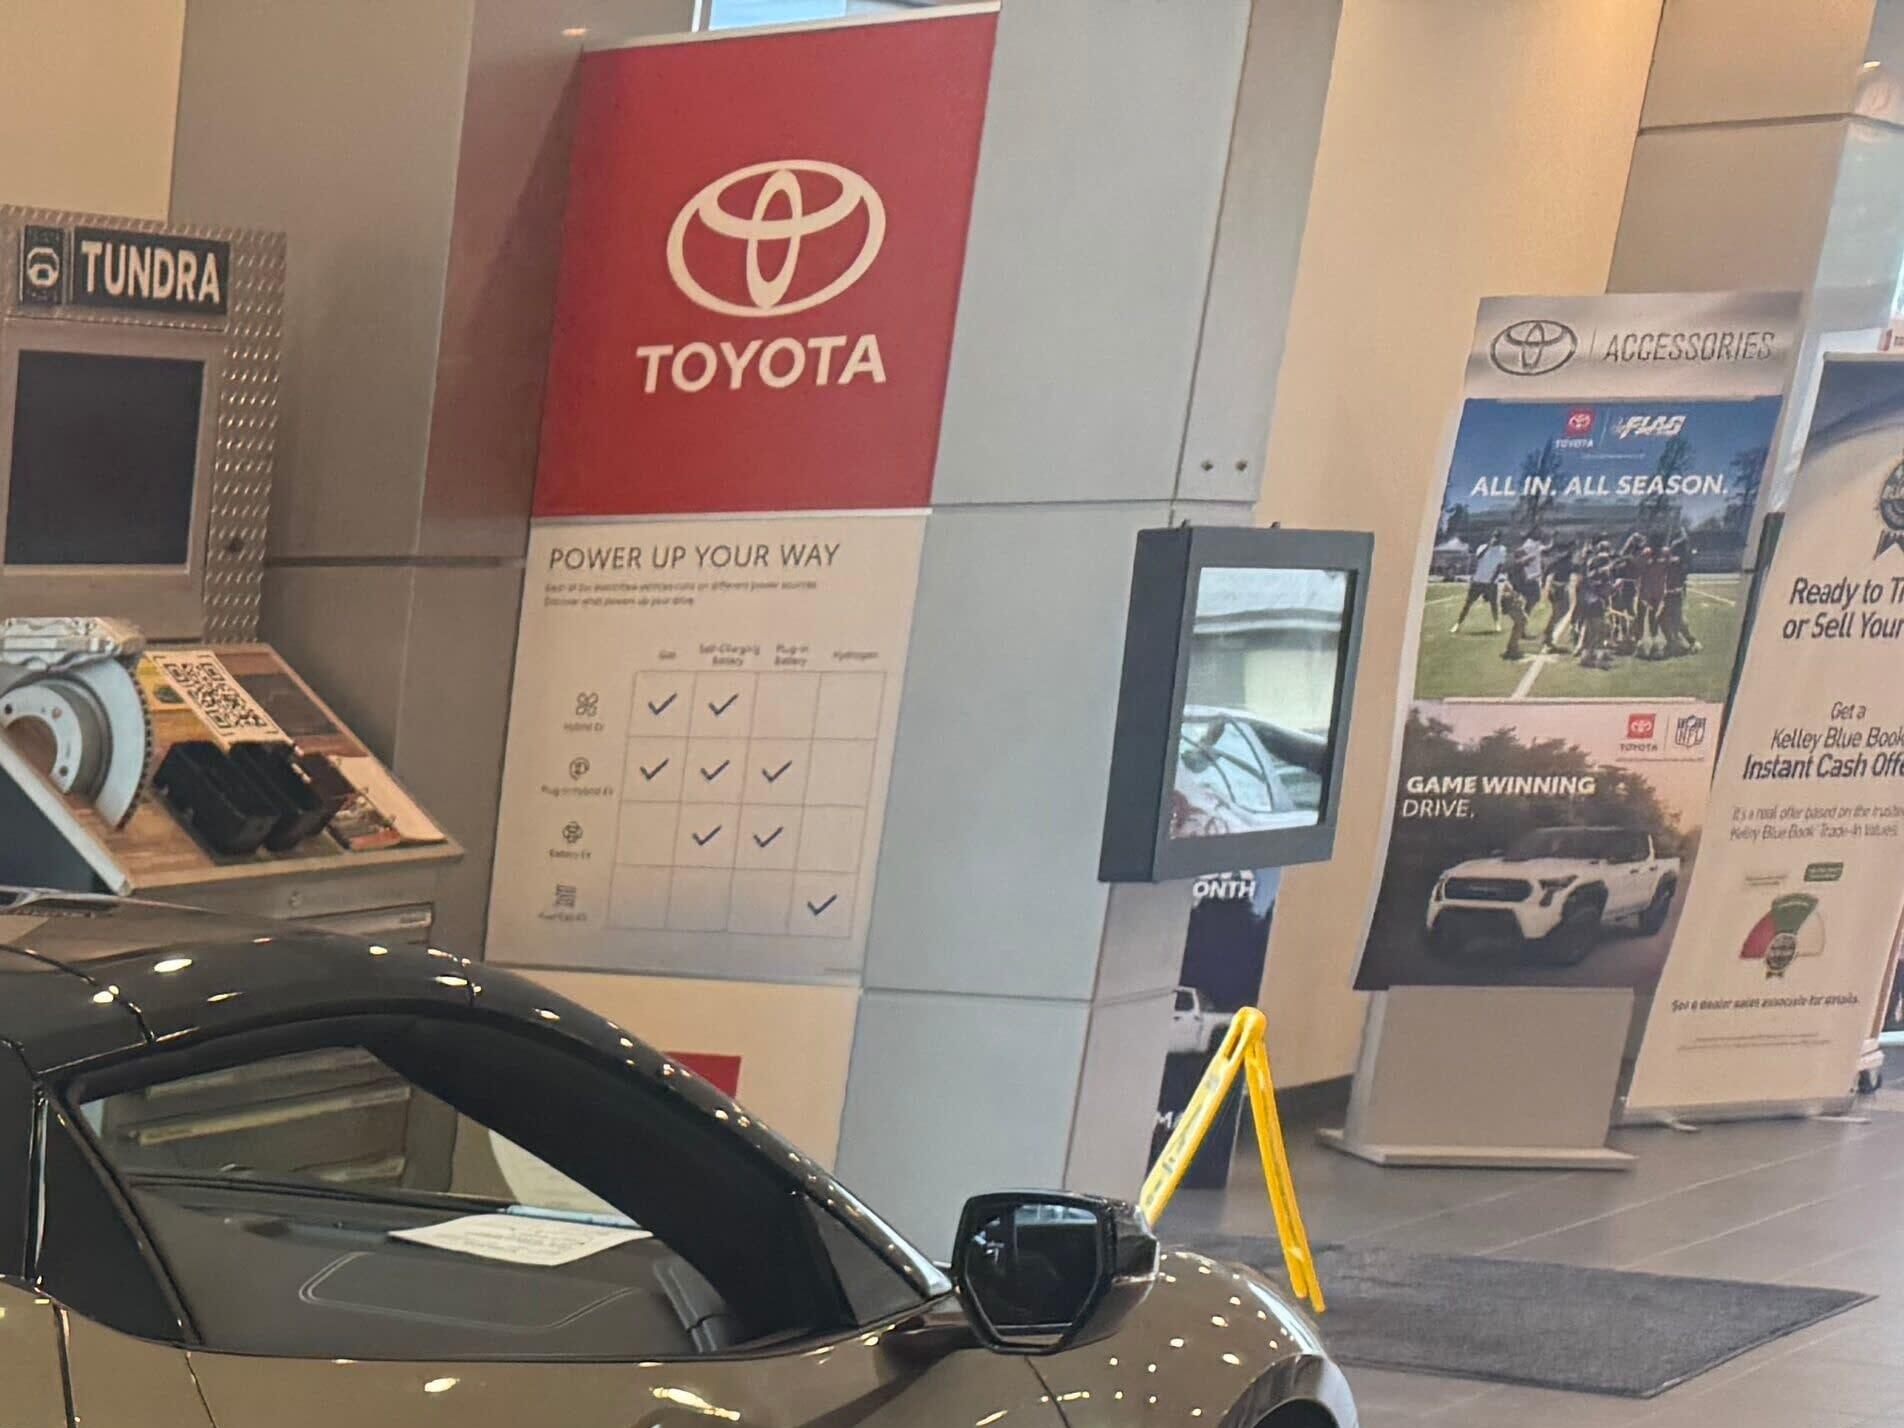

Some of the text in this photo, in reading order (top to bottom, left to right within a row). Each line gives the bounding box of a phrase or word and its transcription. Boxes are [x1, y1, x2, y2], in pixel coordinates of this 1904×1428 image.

[81, 240, 220, 304] TUNDRA
[1602, 330, 1776, 363] ACCESSORIES
[636, 333, 887, 394] TOYOTA
[1470, 473, 1729, 497] ALL IN. ALL SEASON.
[548, 542, 841, 571] POWER UP YOUR WAY
[1789, 576, 1859, 611] Ready
[1863, 579, 1883, 604] to
[1782, 611, 1904, 640] or Sell Your
[1831, 701, 1867, 720] Get a
[1771, 727, 1822, 754] Kelley
[1823, 727, 1863, 749] Blue
[1743, 754, 1815, 780] Instant
[1816, 752, 1867, 778] Cash
[1406, 776, 1596, 795] GAME WINNING
[1402, 799, 1476, 818] DRIVE.
[1193, 879, 1257, 900] ONTH
